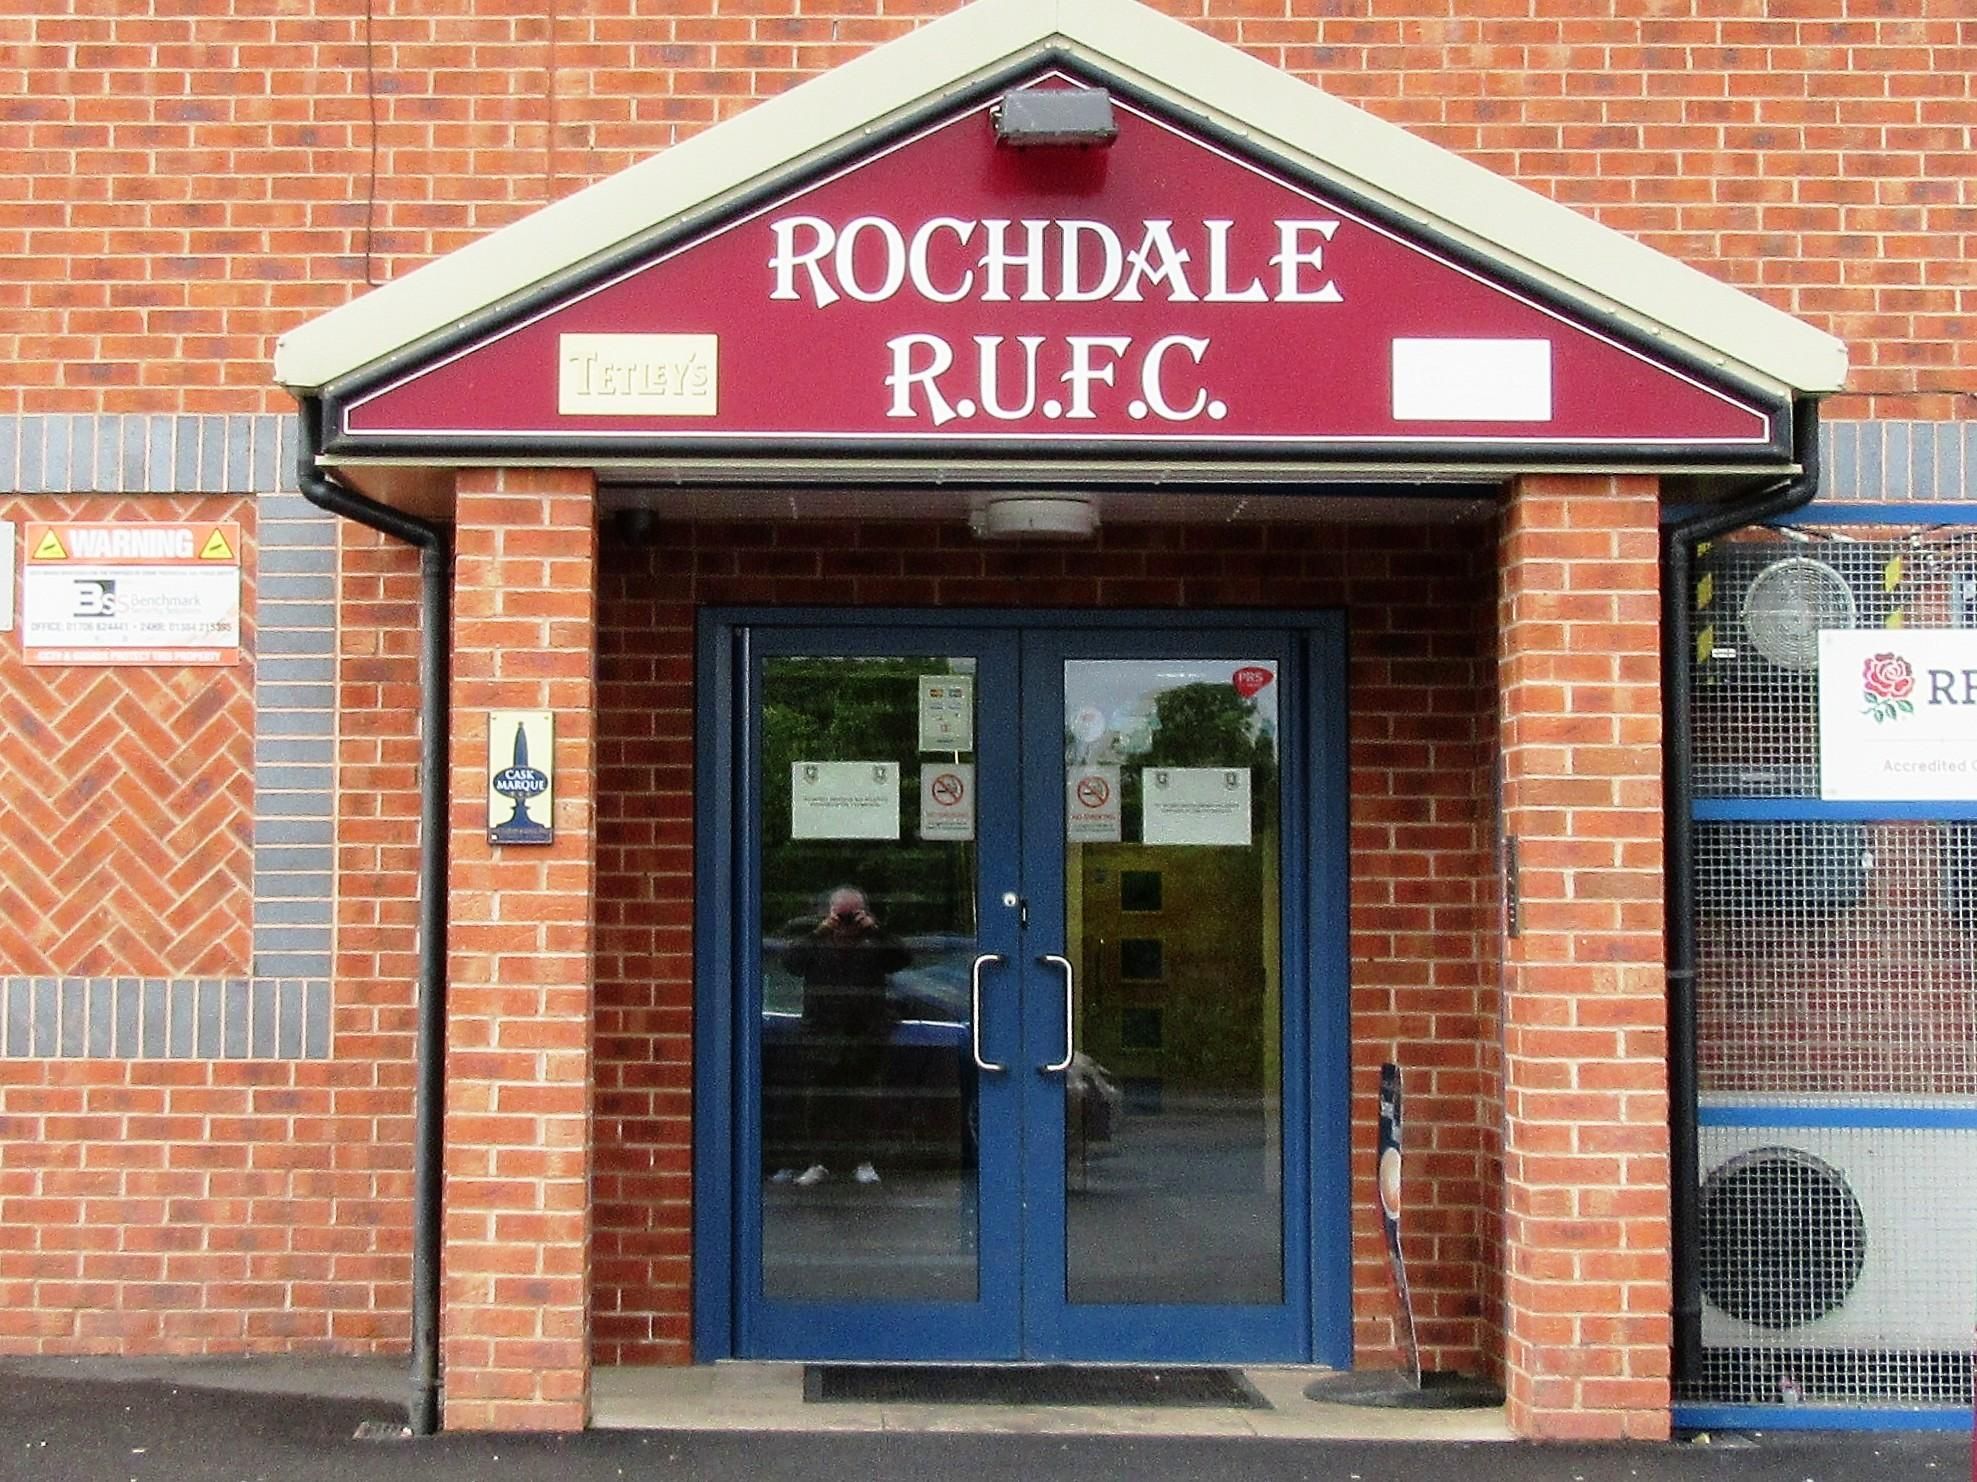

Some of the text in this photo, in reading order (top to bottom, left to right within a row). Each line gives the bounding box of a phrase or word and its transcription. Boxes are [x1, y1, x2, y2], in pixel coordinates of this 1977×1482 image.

[767, 215, 1345, 308] ROCHDALE
[884, 333, 1227, 426] R.U.F.C.
[68, 528, 194, 559] WARNING
[131, 592, 200, 607] Benchmark
[1883, 759, 1967, 773] Accredited
[505, 769, 535, 780] CASK
[496, 779, 545, 791] MARQUE
